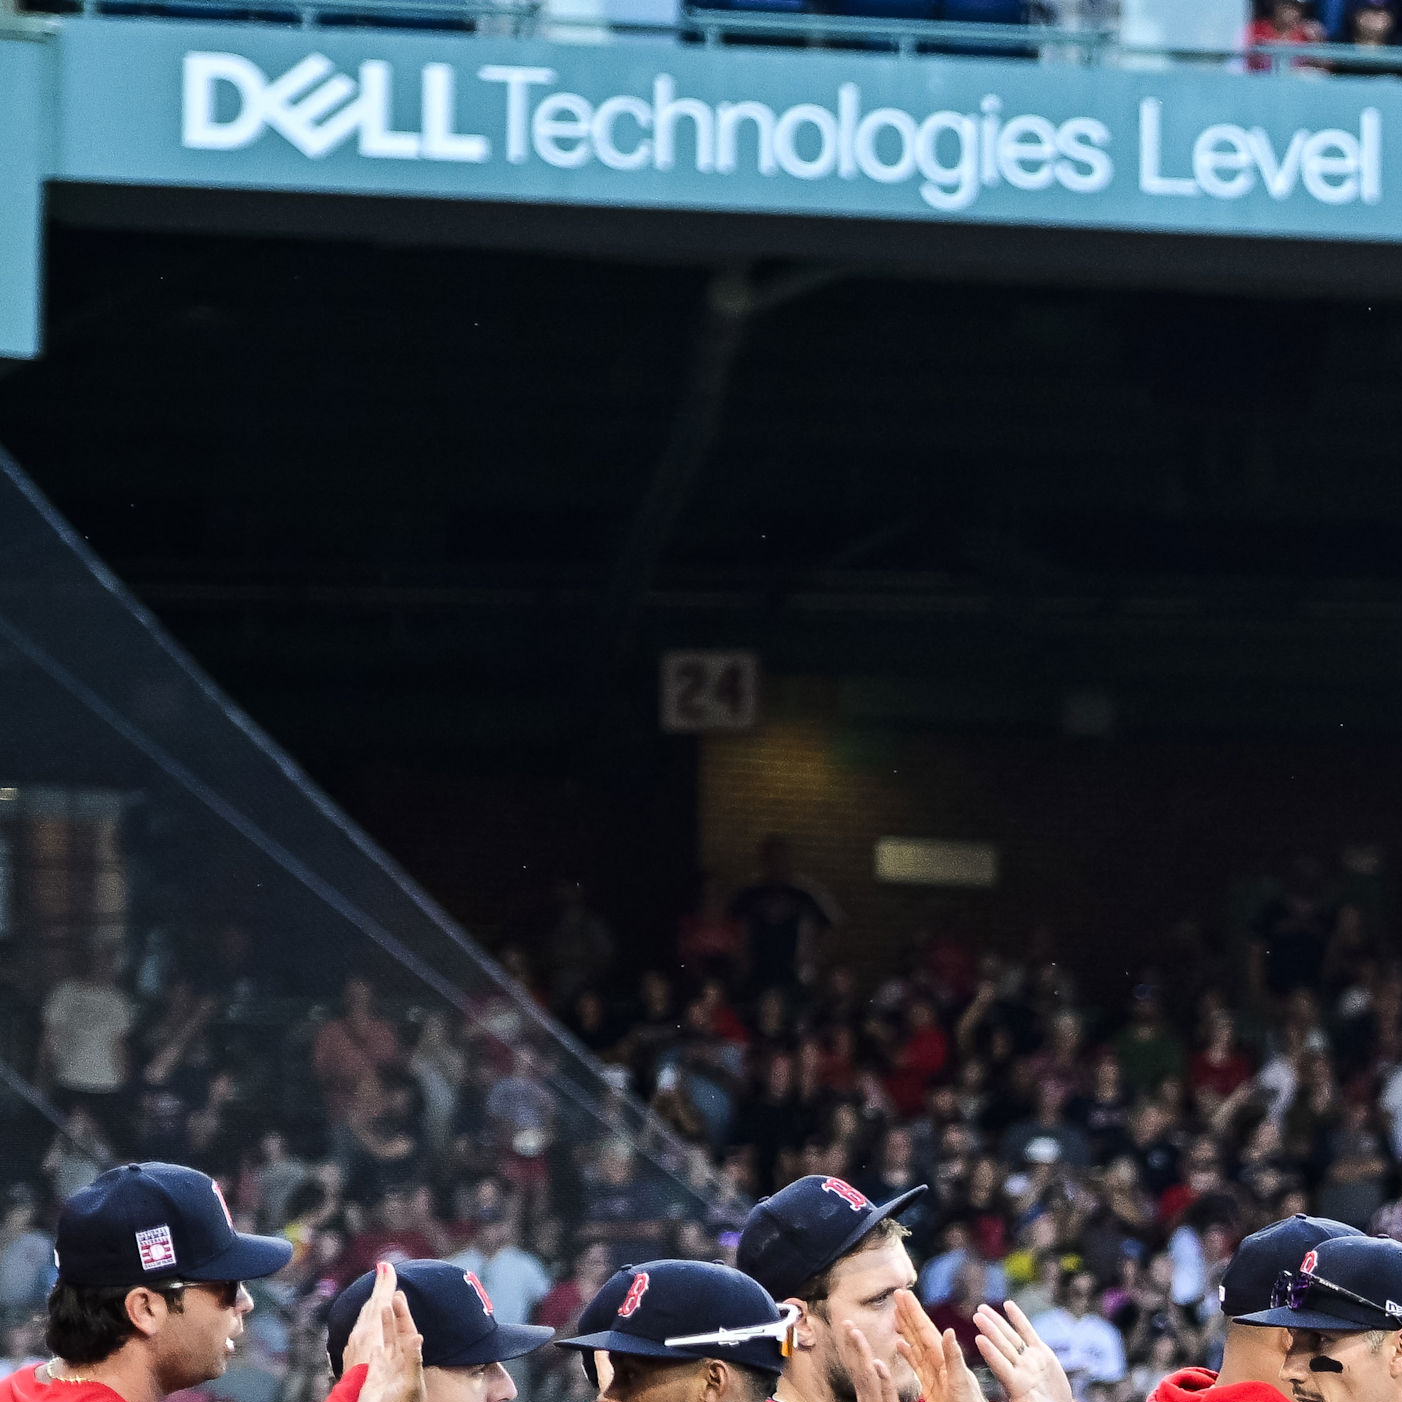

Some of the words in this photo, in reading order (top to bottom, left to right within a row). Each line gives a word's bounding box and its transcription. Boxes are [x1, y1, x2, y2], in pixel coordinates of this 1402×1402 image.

[181, 50, 490, 163] DELL
[477, 65, 1114, 211] Technologies
[1139, 96, 1382, 204] Level
